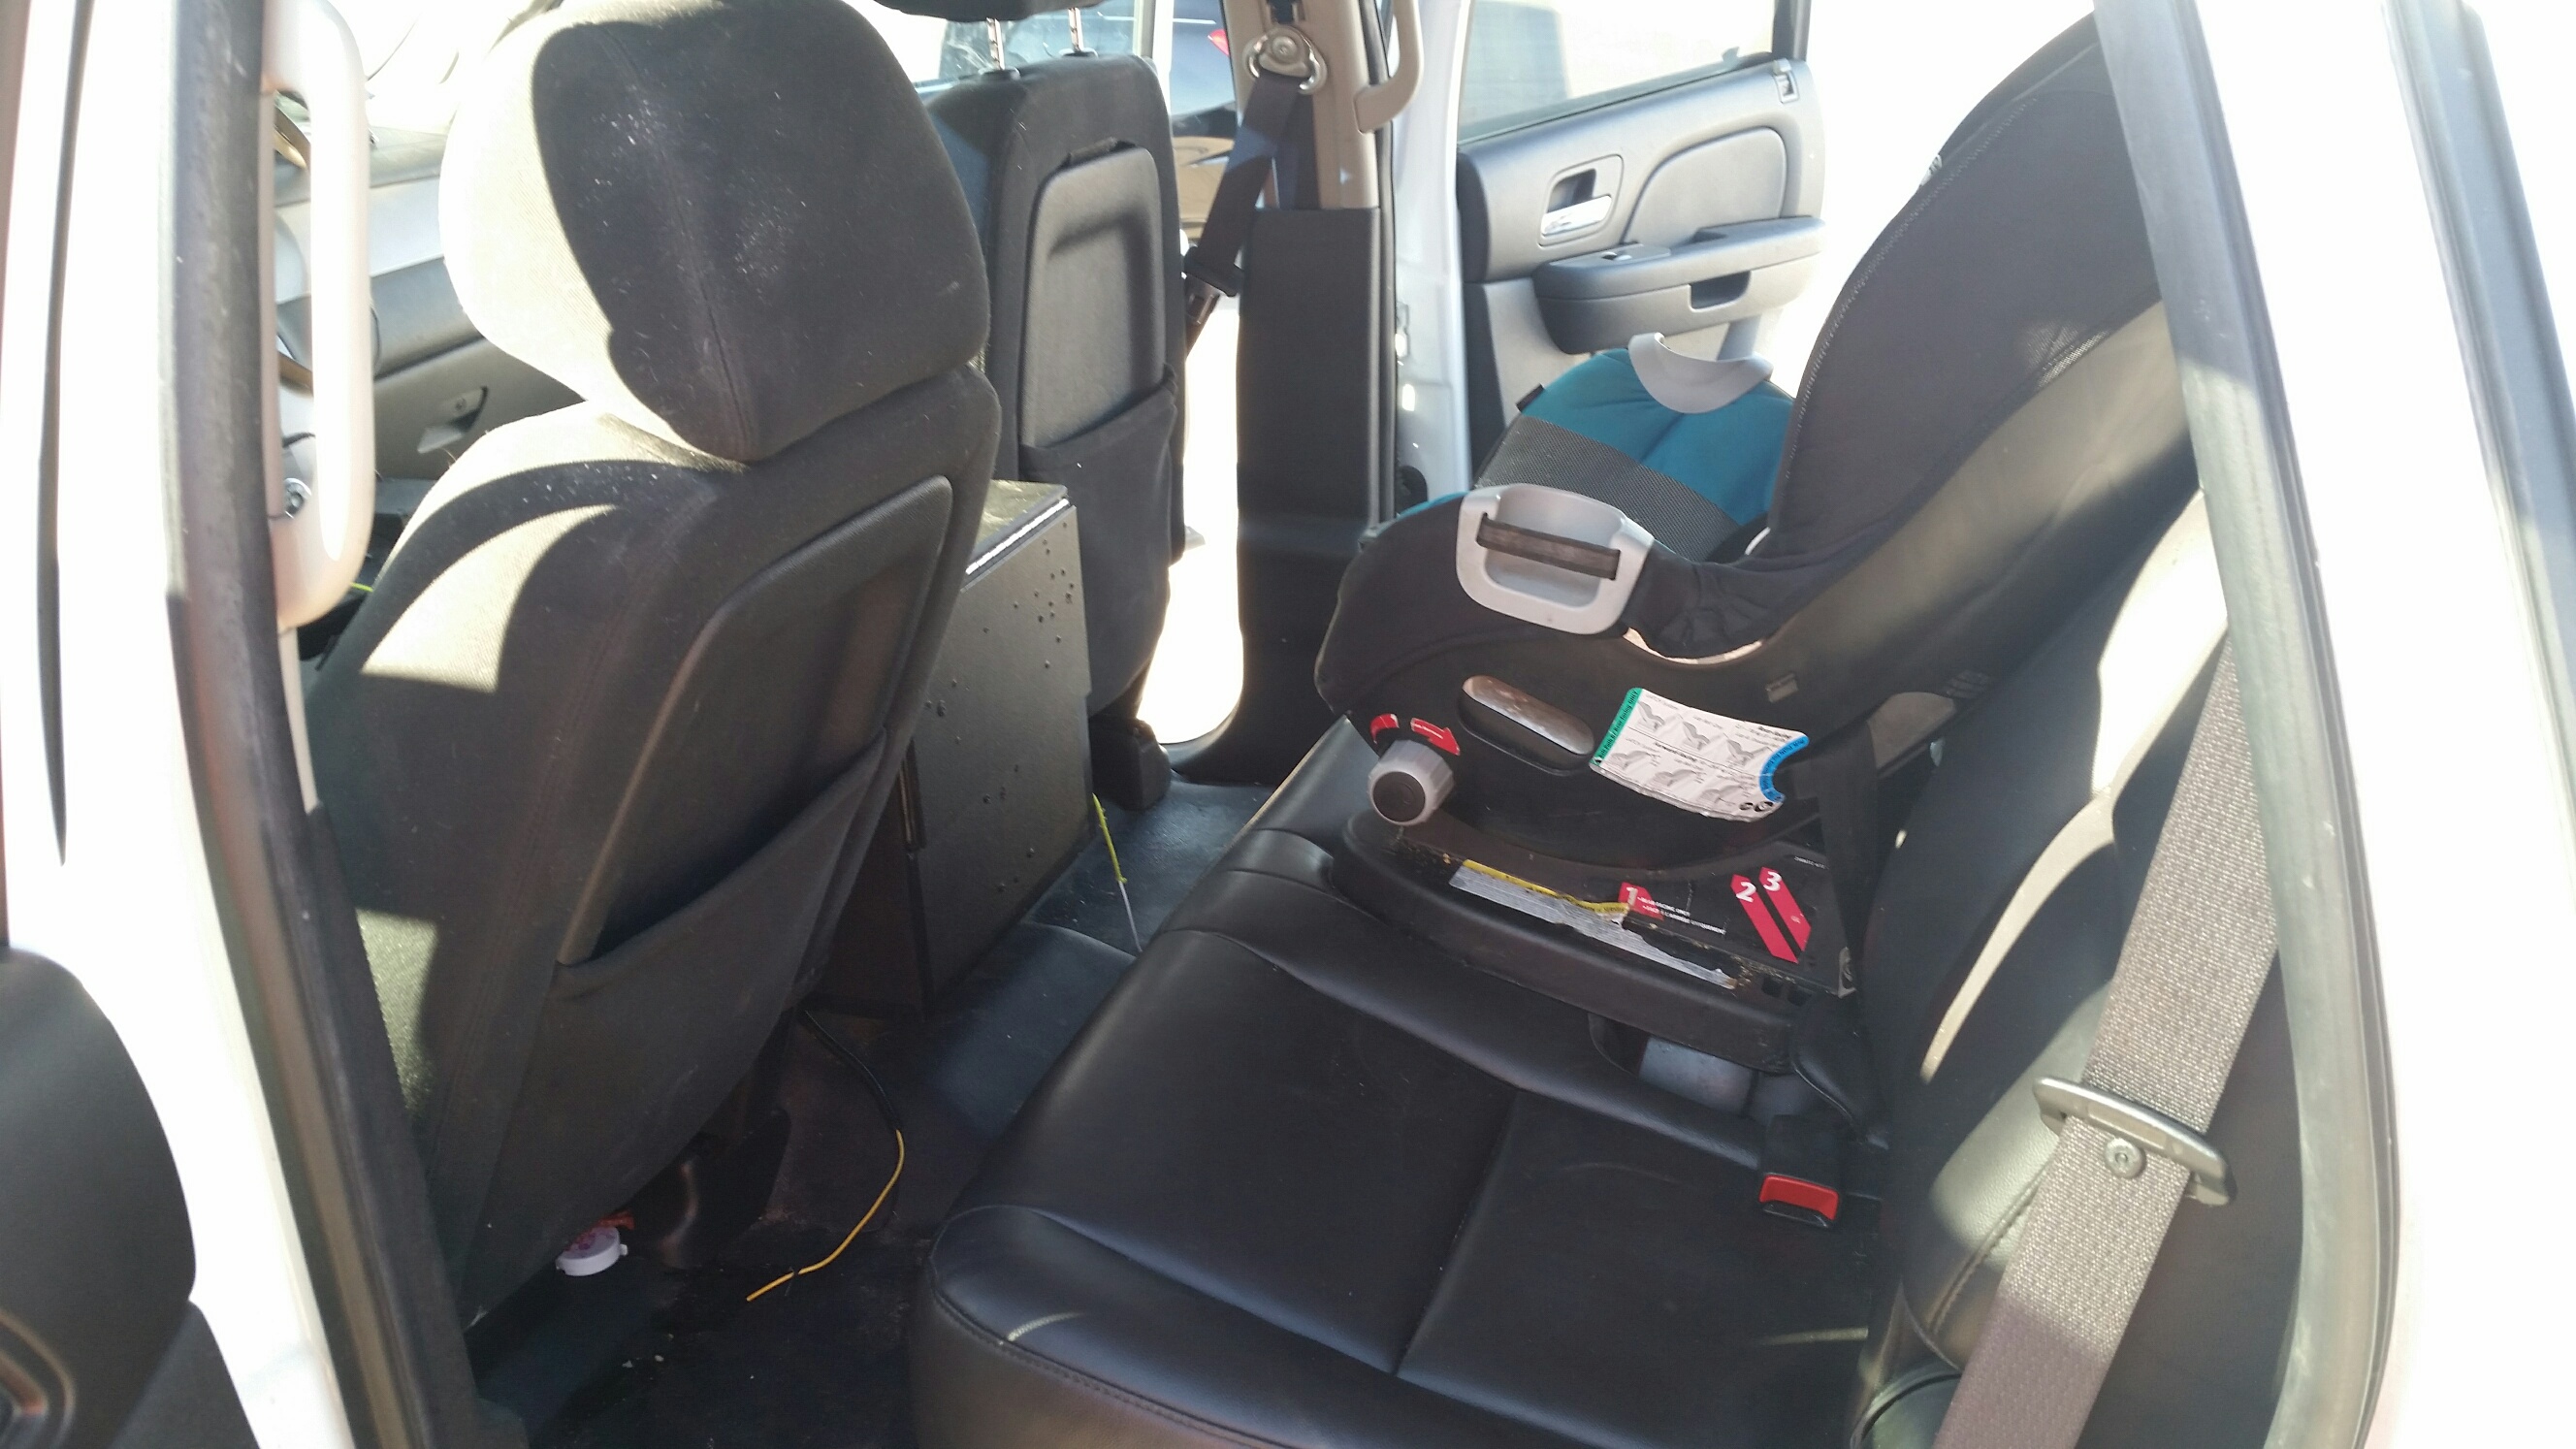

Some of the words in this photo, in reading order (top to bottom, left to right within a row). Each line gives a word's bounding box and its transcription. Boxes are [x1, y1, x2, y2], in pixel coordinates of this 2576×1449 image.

[1763, 871, 1782, 891] 3
[1626, 886, 1639, 906] 1
[1736, 882, 1756, 903] 2
